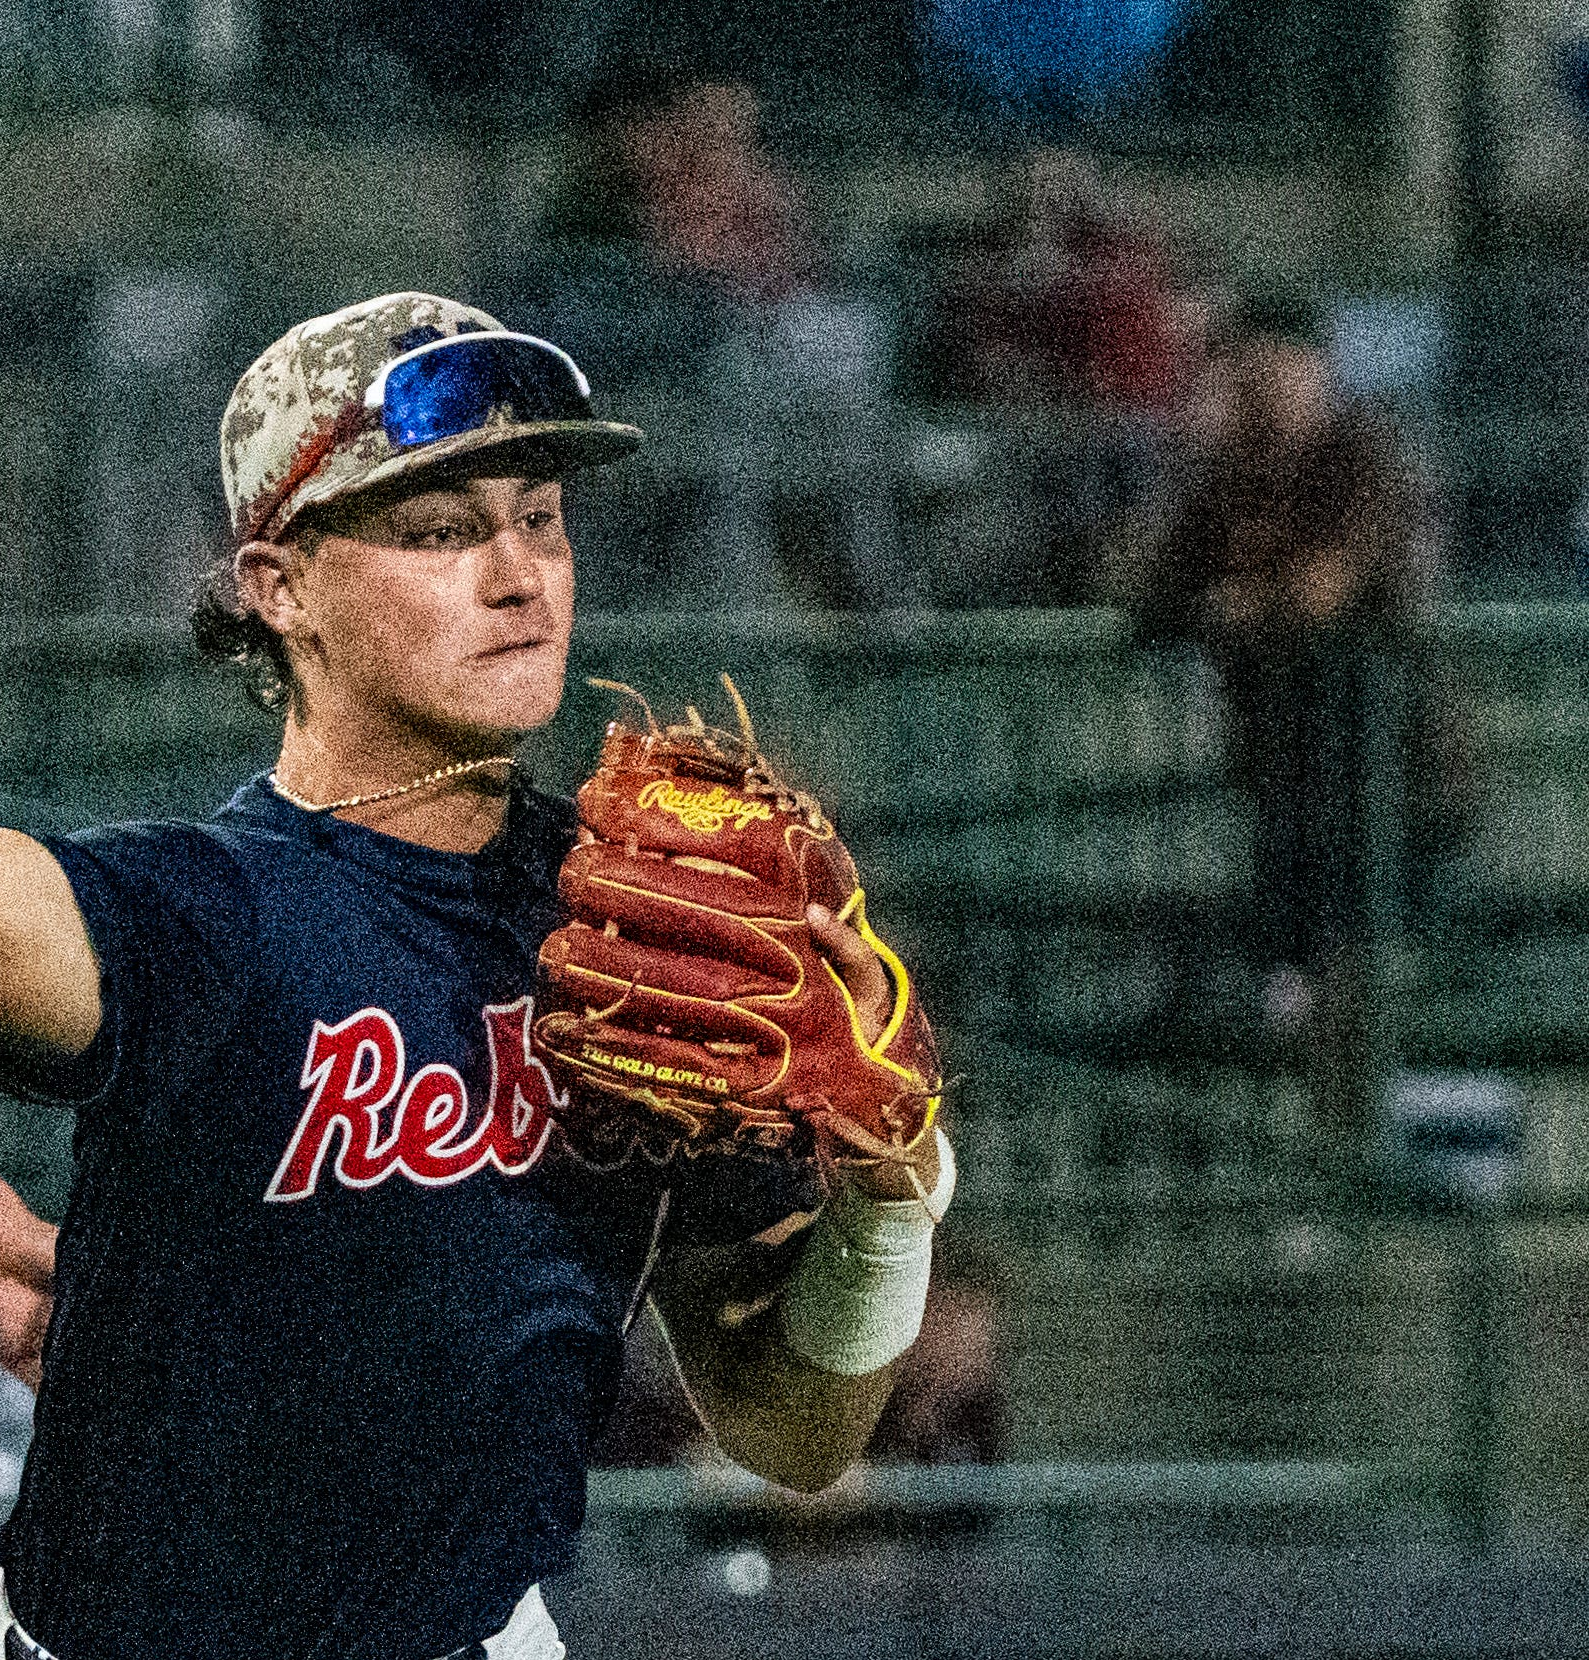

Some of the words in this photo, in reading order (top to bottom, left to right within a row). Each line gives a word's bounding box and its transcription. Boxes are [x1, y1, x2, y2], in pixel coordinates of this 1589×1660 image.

[637, 780, 774, 830] Rawlings
[613, 1056, 655, 1076] GOLD
[656, 1066, 703, 1085] GLOVE
